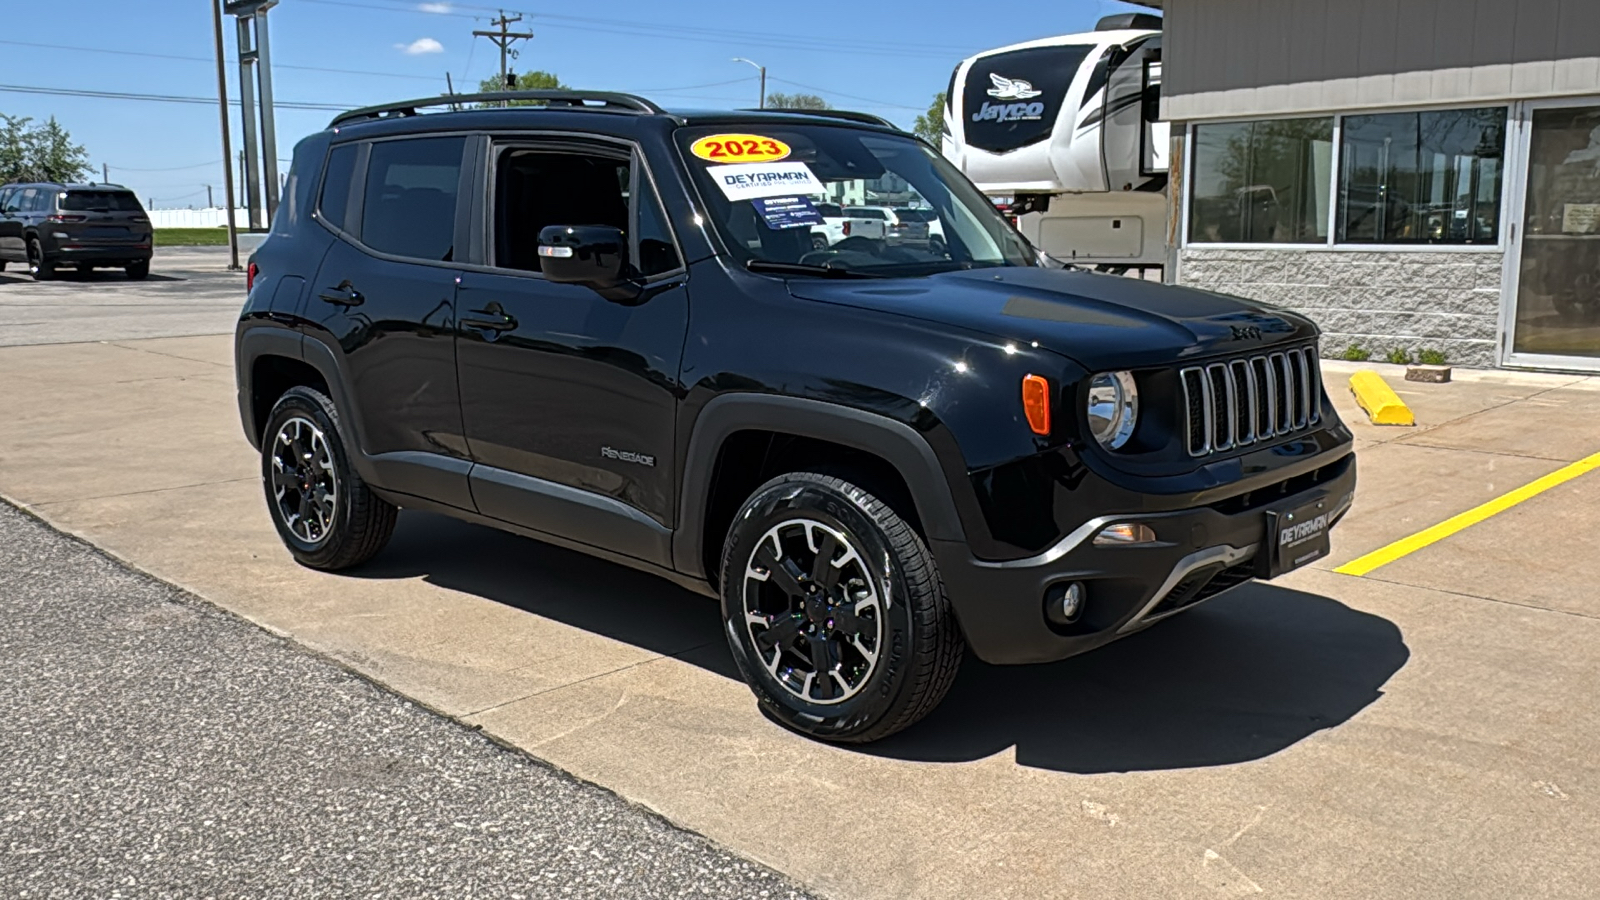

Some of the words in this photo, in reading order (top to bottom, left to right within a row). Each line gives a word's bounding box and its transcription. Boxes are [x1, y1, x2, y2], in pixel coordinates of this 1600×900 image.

[972, 101, 1044, 123] Jayco
[705, 140, 782, 158] 2023
[724, 171, 809, 185] DEYARMAN
[601, 446, 654, 467] RENEGADE
[1280, 513, 1328, 546] DEYARMAN
[880, 628, 903, 697] KUMHO
